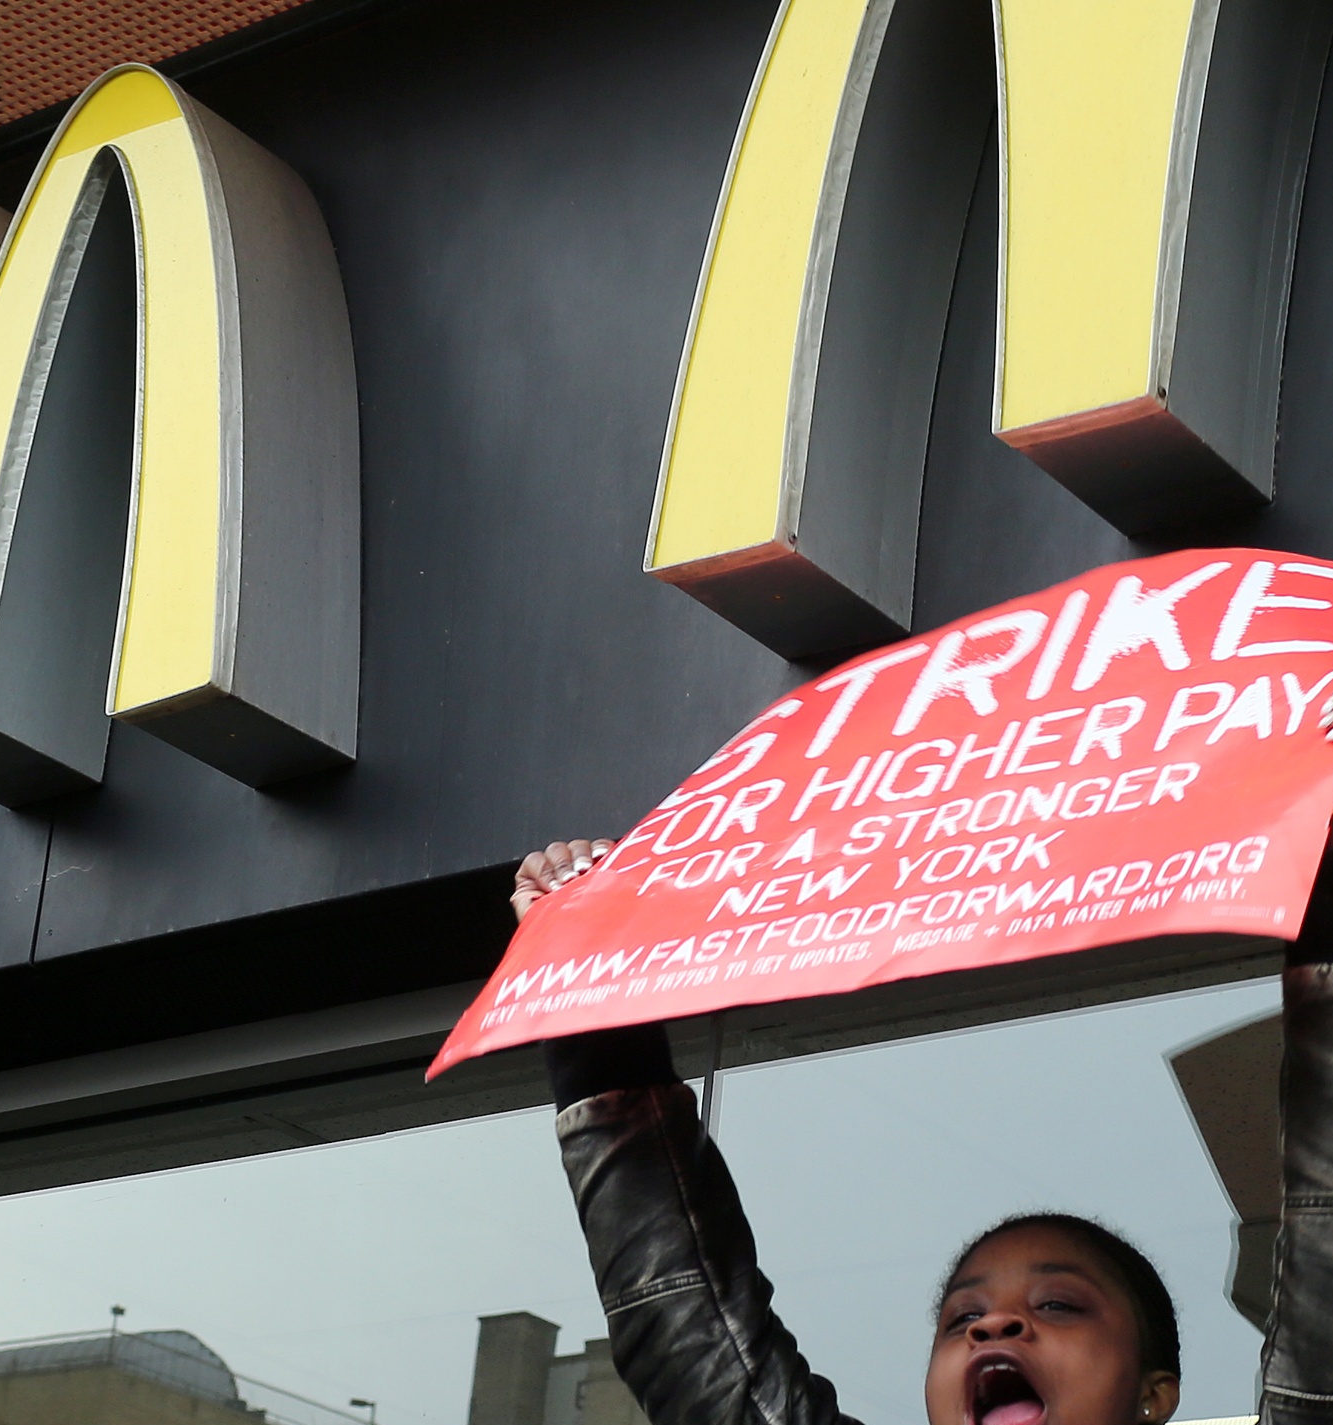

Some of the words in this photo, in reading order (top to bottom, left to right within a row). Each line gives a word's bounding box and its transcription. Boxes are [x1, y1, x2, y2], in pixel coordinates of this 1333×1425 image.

[598, 779, 786, 873] FOR
[788, 695, 1147, 822] HIGHER
[636, 841, 765, 896] FOR
[773, 828, 817, 871] A
[840, 762, 1201, 857] STRONGER
[493, 835, 1270, 1009] WWW.FASTFOODFORWARD.ORG
[624, 976, 648, 998] TO
[723, 962, 747, 982] TO
[749, 953, 787, 977] GET
[891, 922, 979, 955] MESSAGE
[1005, 911, 1057, 938] DATA
[1061, 898, 1127, 927] RATES
[1128, 887, 1176, 916] MAY
[706, 862, 873, 922] NEW
[894, 829, 1066, 890] YORK
